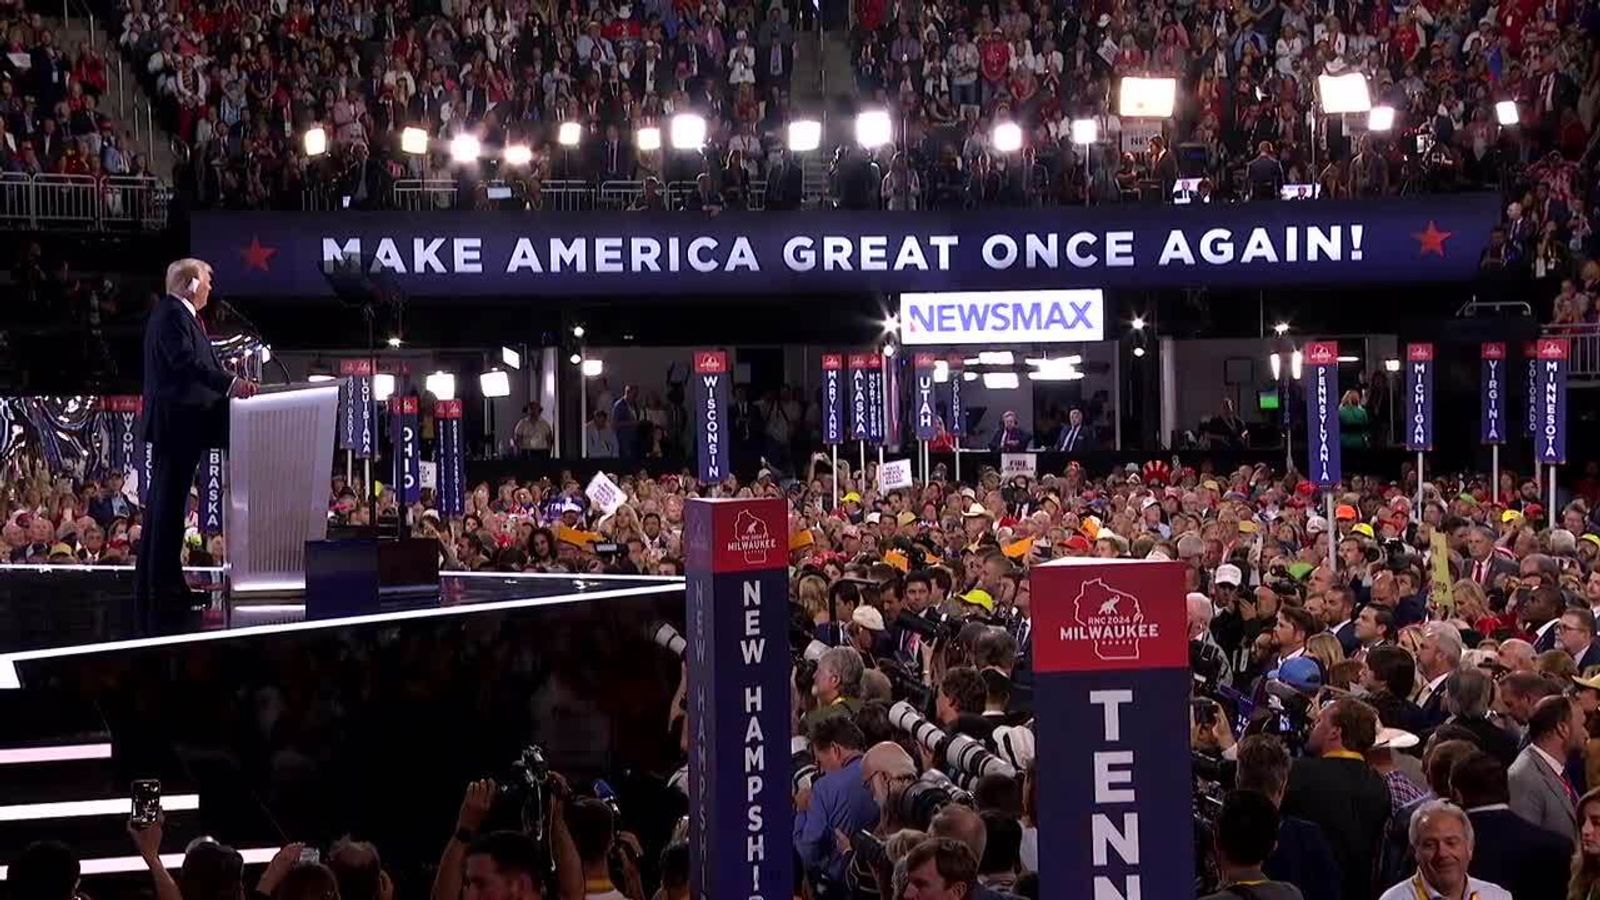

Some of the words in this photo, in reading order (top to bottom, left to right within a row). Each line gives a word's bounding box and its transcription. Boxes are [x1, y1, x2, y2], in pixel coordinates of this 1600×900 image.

[322, 237, 482, 273] MAKE
[507, 236, 760, 273] AMERICA
[784, 235, 958, 271] GREAT
[982, 231, 1134, 269] ONCE
[1158, 224, 1363, 266] AGAIN!
[909, 301, 1093, 333] NEWSMAX
[361, 376, 371, 453] LOUISIANA
[703, 375, 719, 477] WISCONSIN
[828, 370, 837, 439] MARYLAND
[854, 369, 866, 433] ALASKA
[920, 376, 932, 428] UTAH
[1318, 366, 1329, 480] PENNSYLVANIA
[1414, 363, 1425, 443] MICHIGAN
[1488, 360, 1498, 438] VIRGINIA
[1529, 360, 1537, 431] COLORADO
[1545, 361, 1557, 456] MINNESOTA
[122, 412, 135, 479] WYOMIN
[727, 538, 776, 552] MILWAUKEE
[740, 580, 765, 665] NEW
[1060, 624, 1159, 641] MILWAUKEE
[1088, 617, 1105, 625] RNC
[1108, 616, 1130, 624] 2024
[744, 686, 765, 900] HAMPSHI
